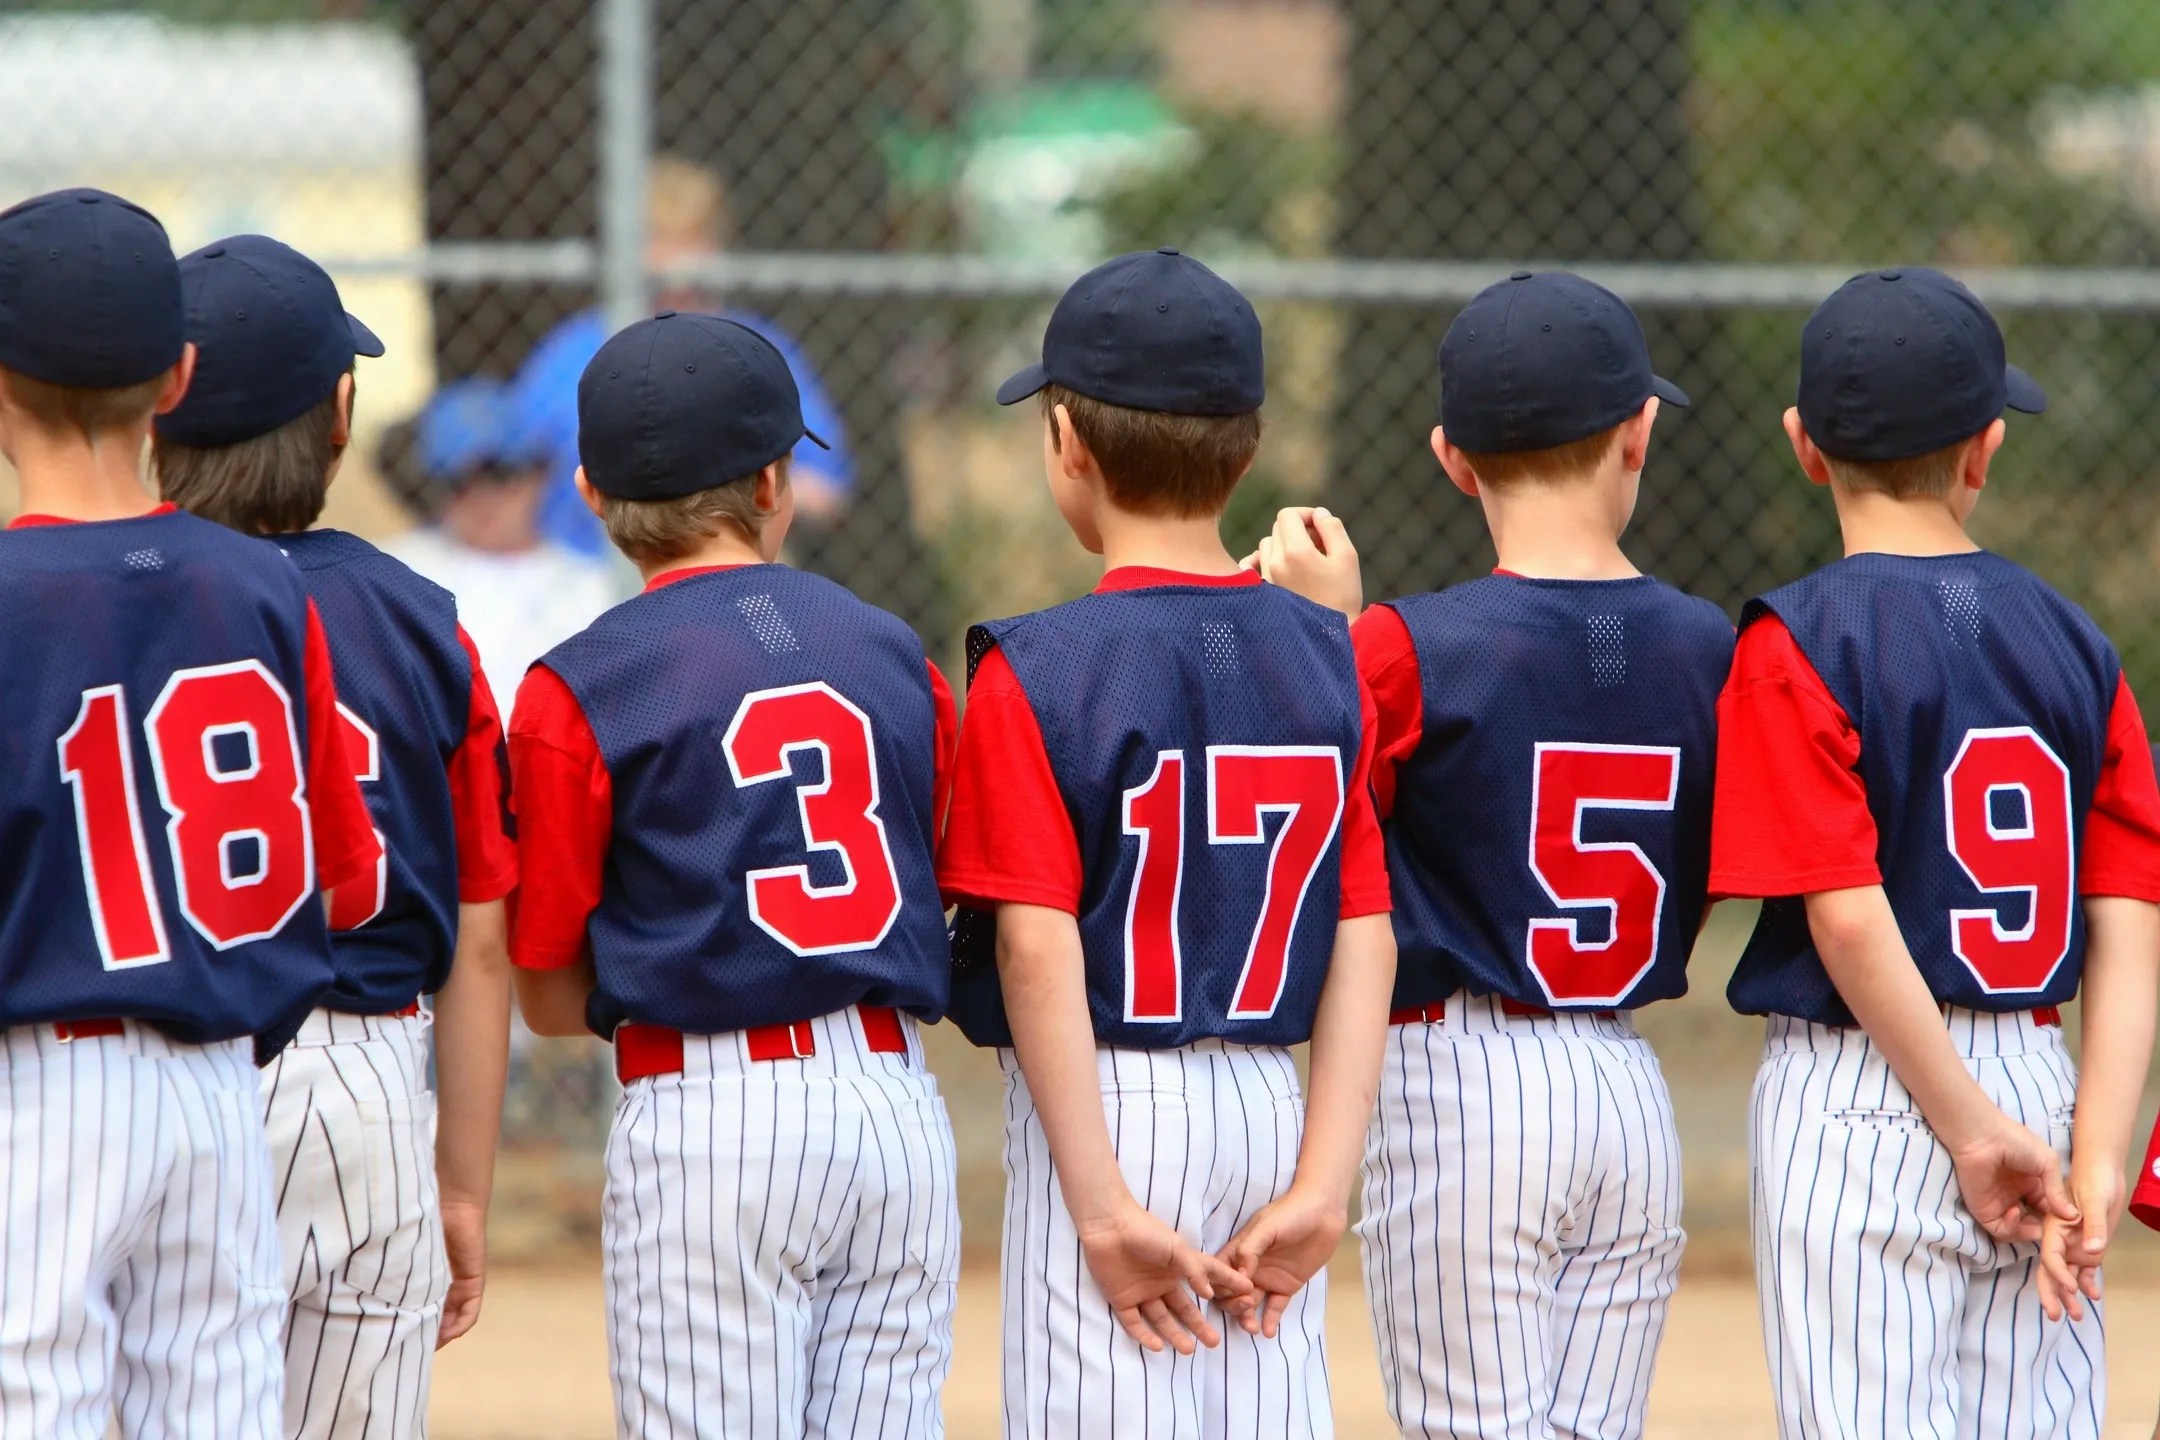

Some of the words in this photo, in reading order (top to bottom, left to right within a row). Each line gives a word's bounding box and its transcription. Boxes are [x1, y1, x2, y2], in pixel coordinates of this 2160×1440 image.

[57, 658, 315, 971] 18
[722, 681, 902, 957] 3
[1122, 745, 1344, 1023] 17
[1526, 741, 1681, 1007] 5
[1943, 726, 2075, 994] 9
